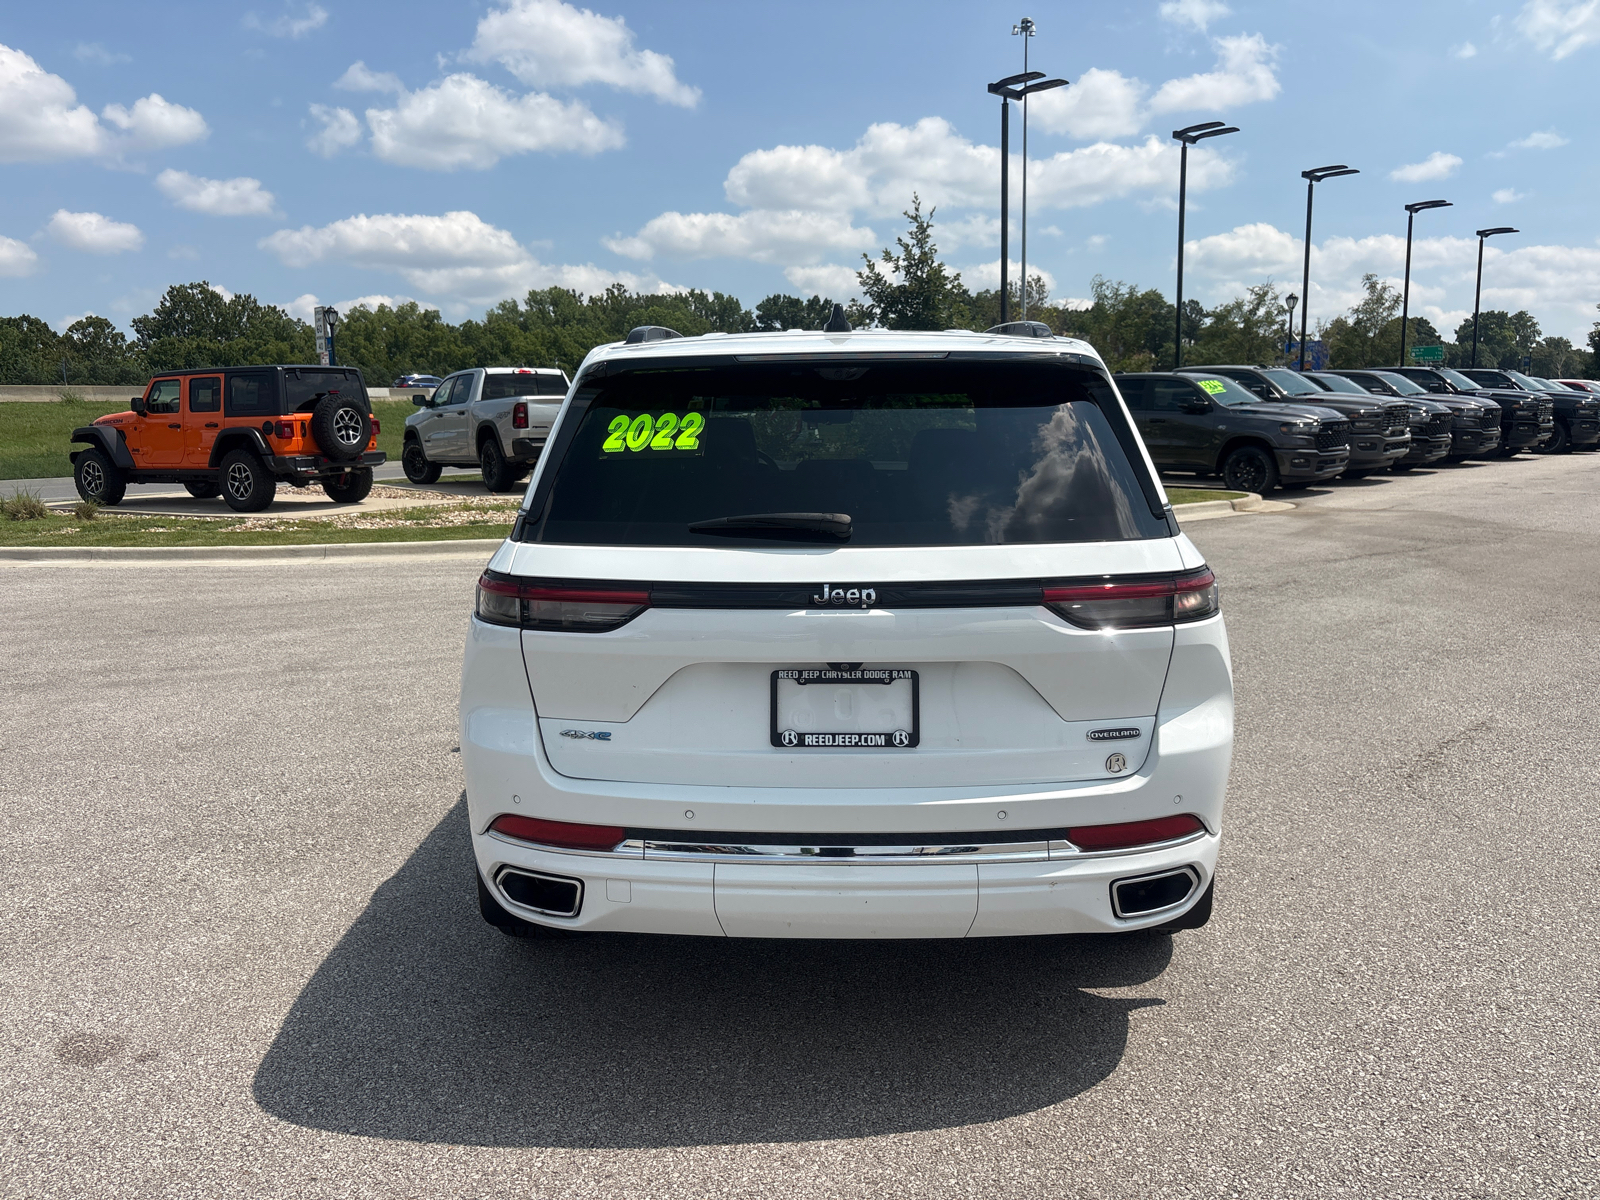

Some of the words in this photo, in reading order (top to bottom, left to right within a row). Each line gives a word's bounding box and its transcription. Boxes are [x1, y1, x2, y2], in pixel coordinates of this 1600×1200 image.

[94, 418, 124, 426] RUBICON
[602, 411, 706, 453] 2022
[813, 584, 877, 608] Jeep
[778, 670, 799, 679] REED
[801, 670, 820, 679] JEEP
[821, 670, 862, 679] CHRYSLER
[864, 670, 890, 679] DODGE
[892, 670, 912, 679] RAM
[1091, 730, 1139, 738] OVERLAND
[804, 734, 886, 746] REEDJEEP.COM
